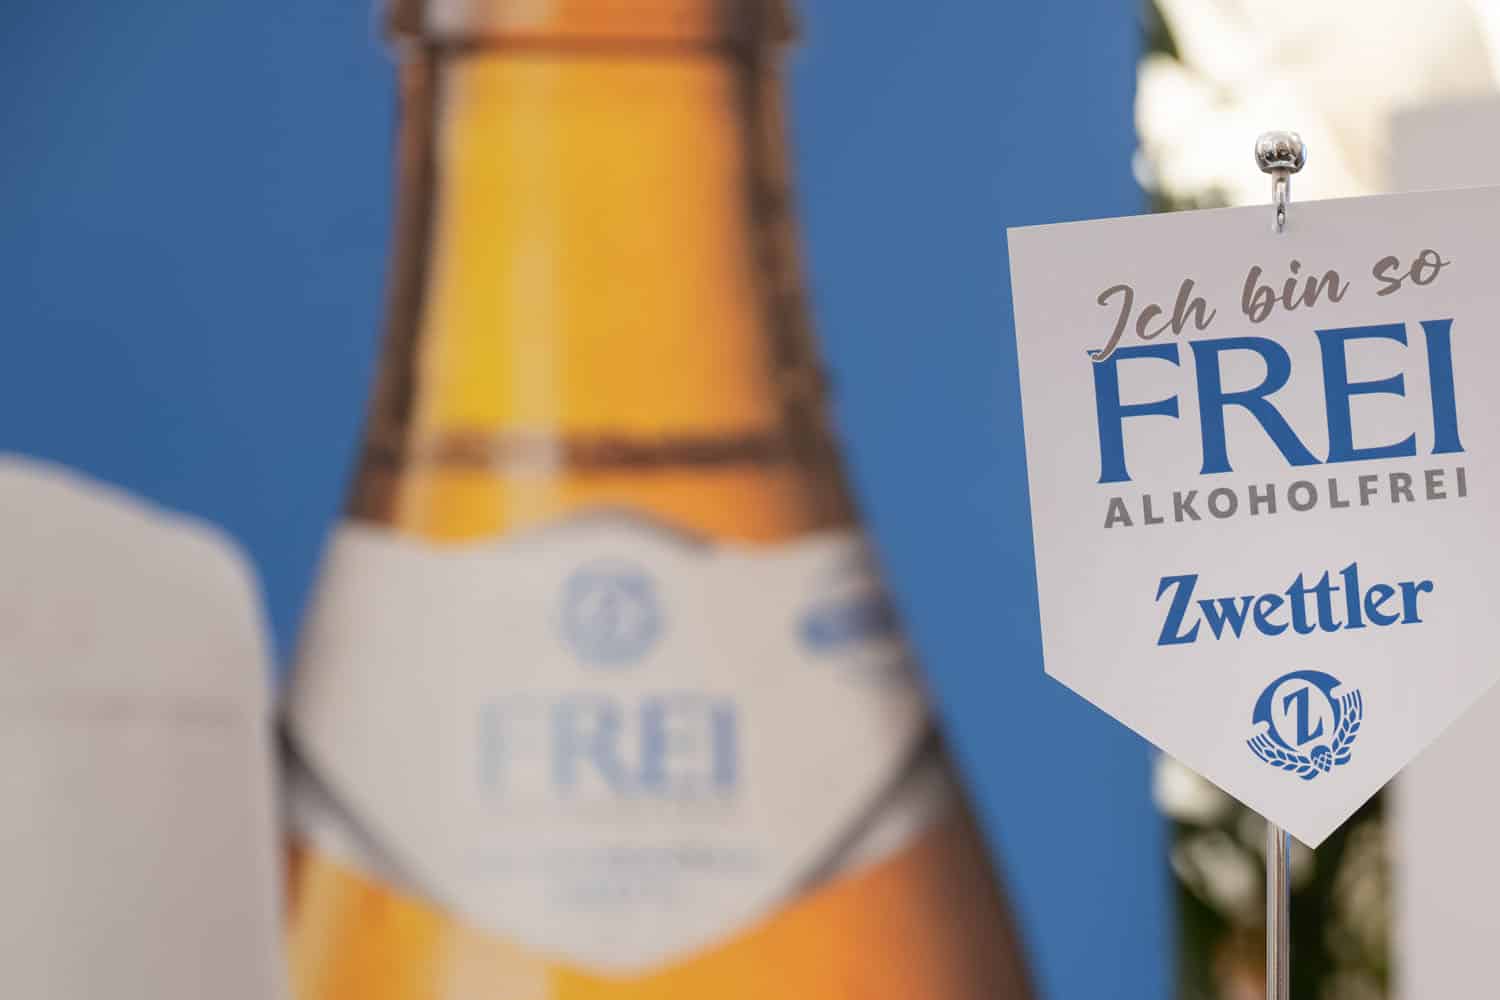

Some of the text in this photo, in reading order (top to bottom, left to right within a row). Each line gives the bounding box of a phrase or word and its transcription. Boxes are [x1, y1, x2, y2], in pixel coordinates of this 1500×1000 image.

[1091, 248, 1451, 362] Ich bin so
[1087, 318, 1467, 485] FREI
[1103, 466, 1468, 529] ALKOHOLFREI
[1155, 561, 1434, 646] Zwettler
